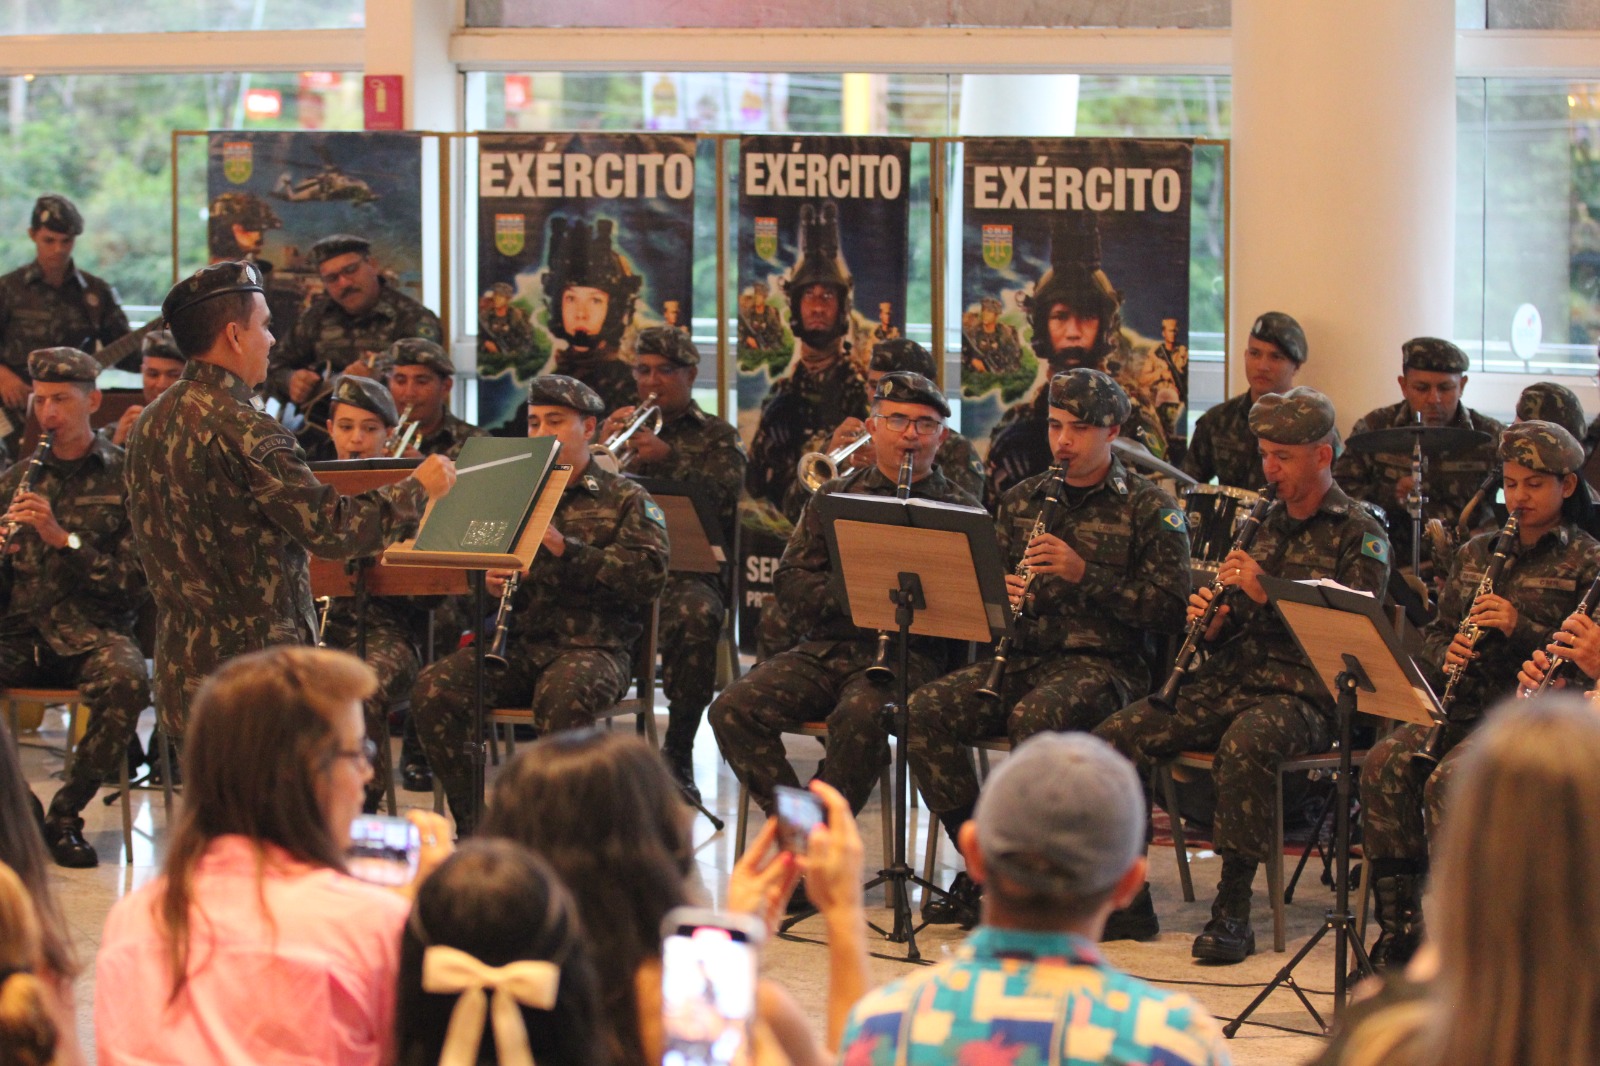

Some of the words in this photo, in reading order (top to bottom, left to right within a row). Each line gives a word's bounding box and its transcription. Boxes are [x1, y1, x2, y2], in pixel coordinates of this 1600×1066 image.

[479, 142, 693, 199] EXÉRCITO
[745, 142, 902, 200] EXÉRCITO
[973, 156, 1181, 213] EXÉRCITO
[258, 438, 287, 452] SELVA
